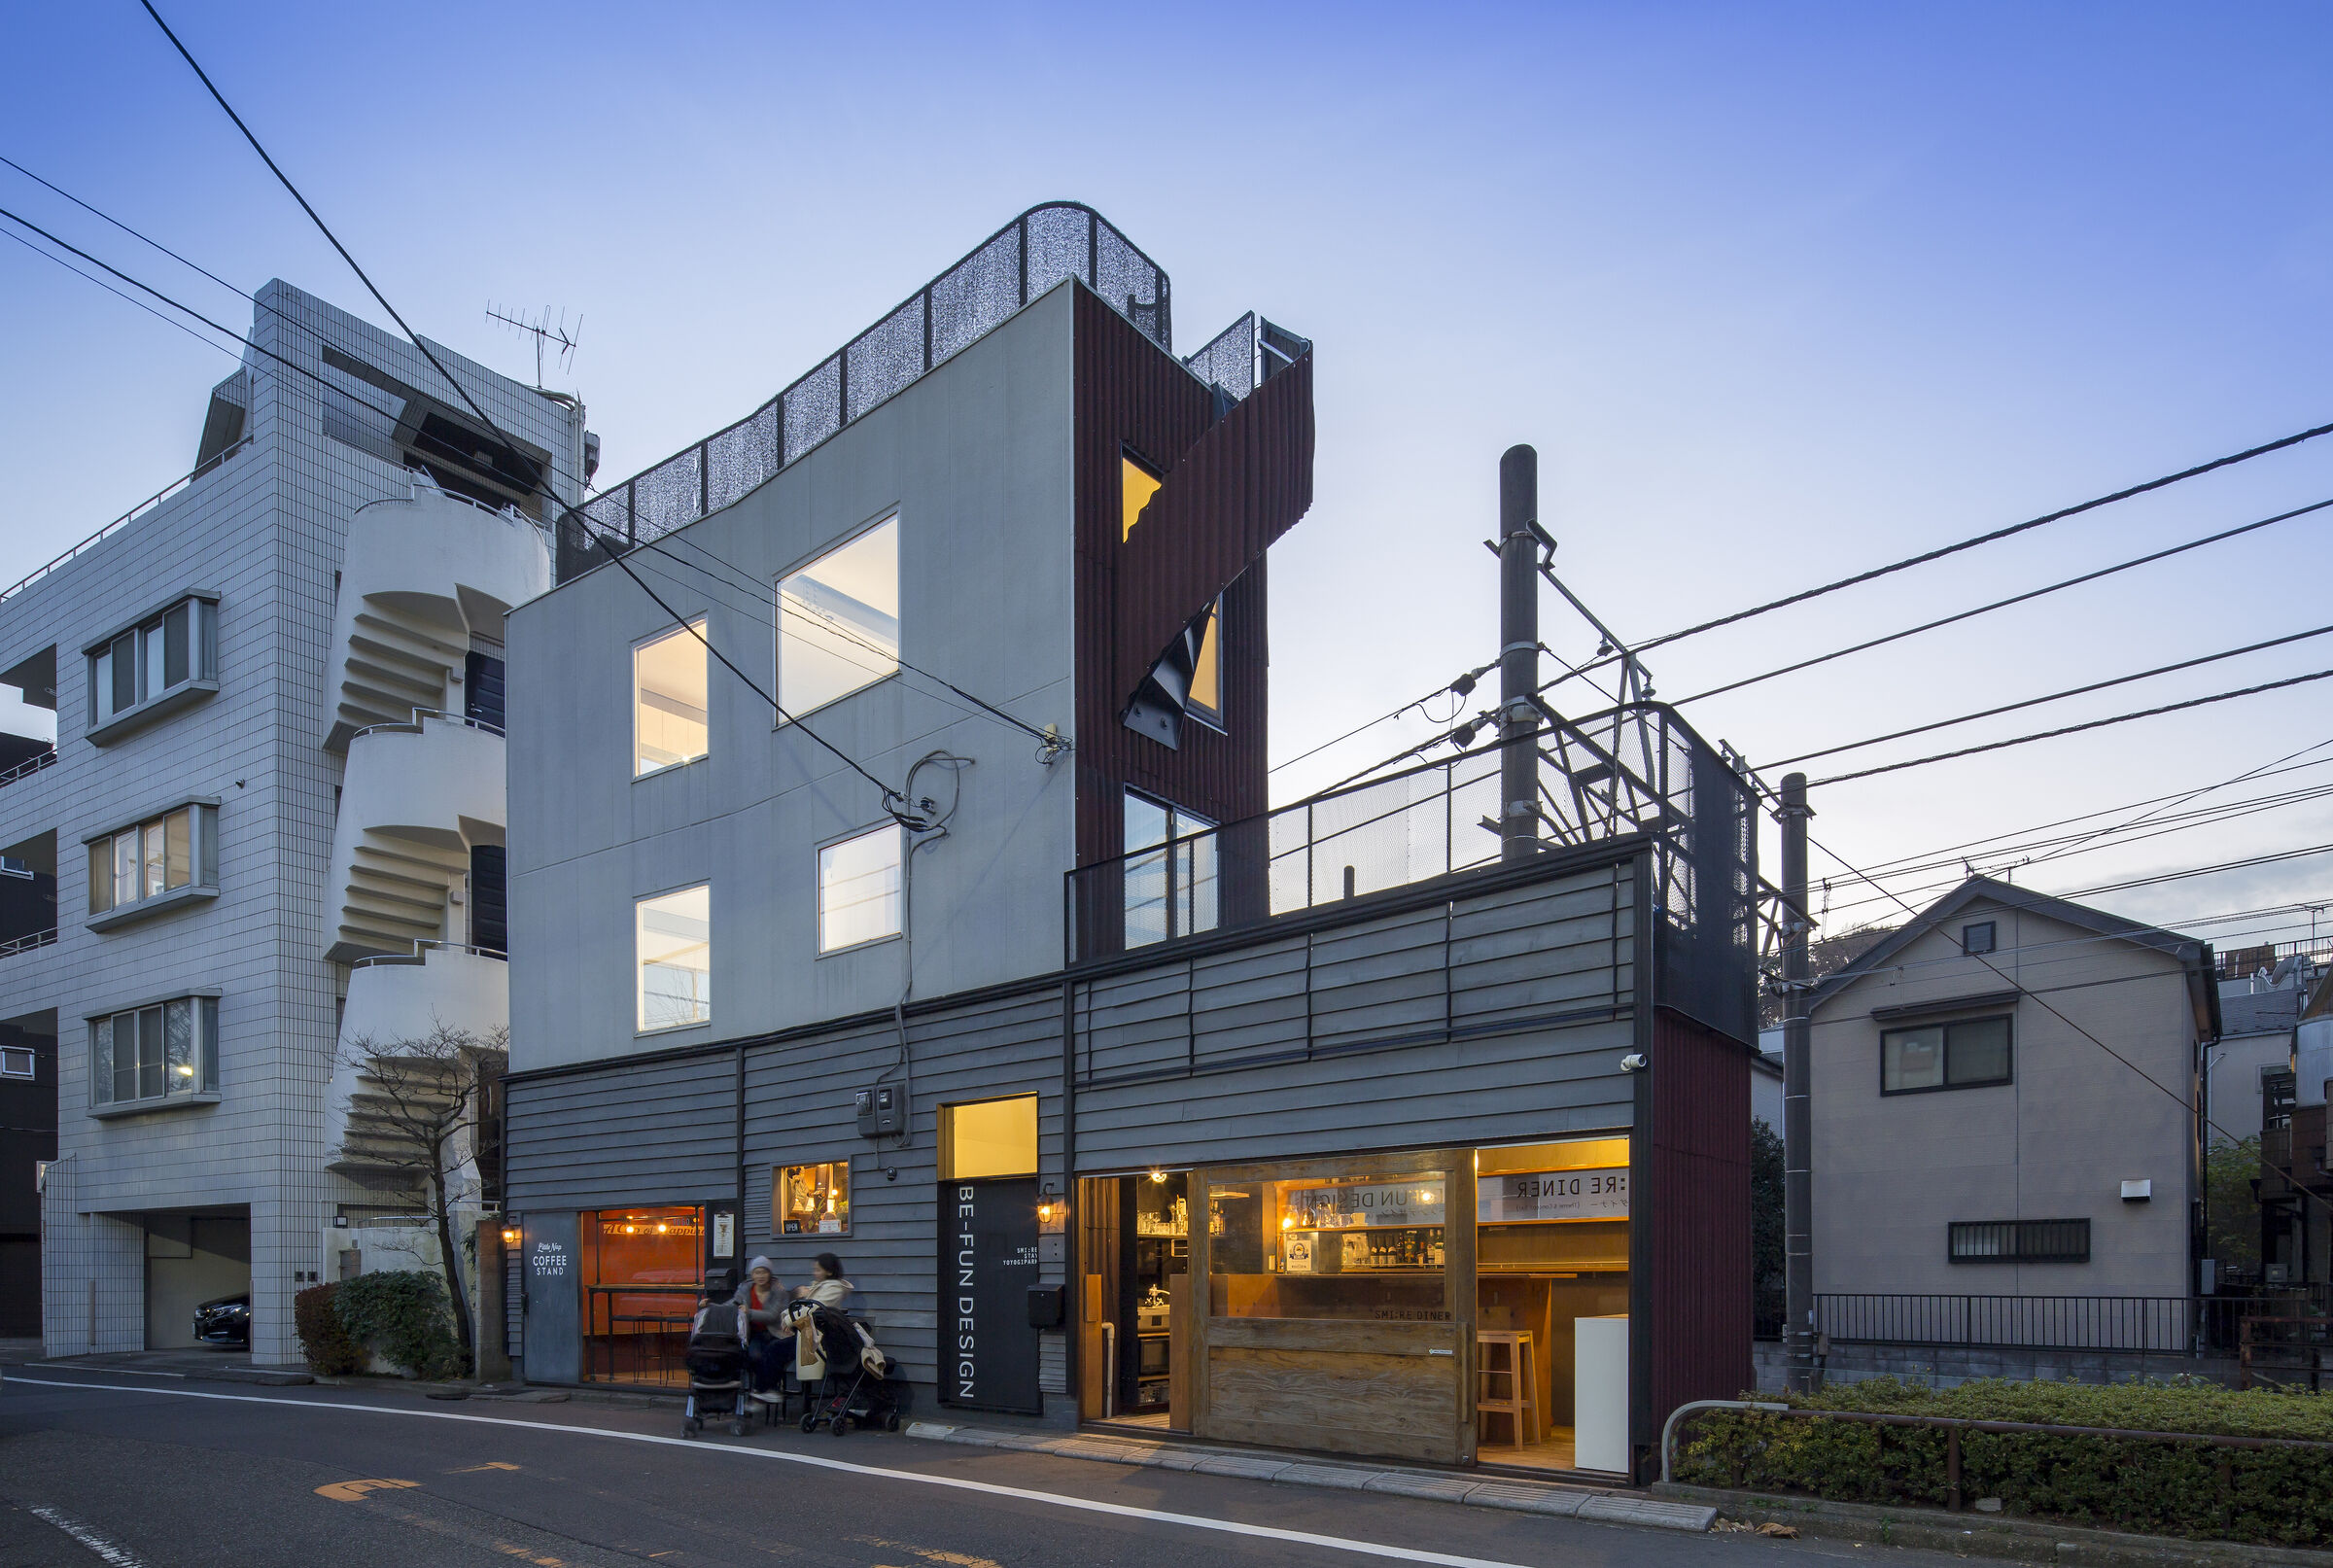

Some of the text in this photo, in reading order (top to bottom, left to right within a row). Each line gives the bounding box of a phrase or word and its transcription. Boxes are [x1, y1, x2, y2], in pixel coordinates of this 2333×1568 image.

[533, 1255, 567, 1266] COFFEE
[536, 1267, 564, 1275] STAND
[958, 1186, 975, 1398] BE-FUN DESIGN
[1416, 1310, 1451, 1321] DINER
